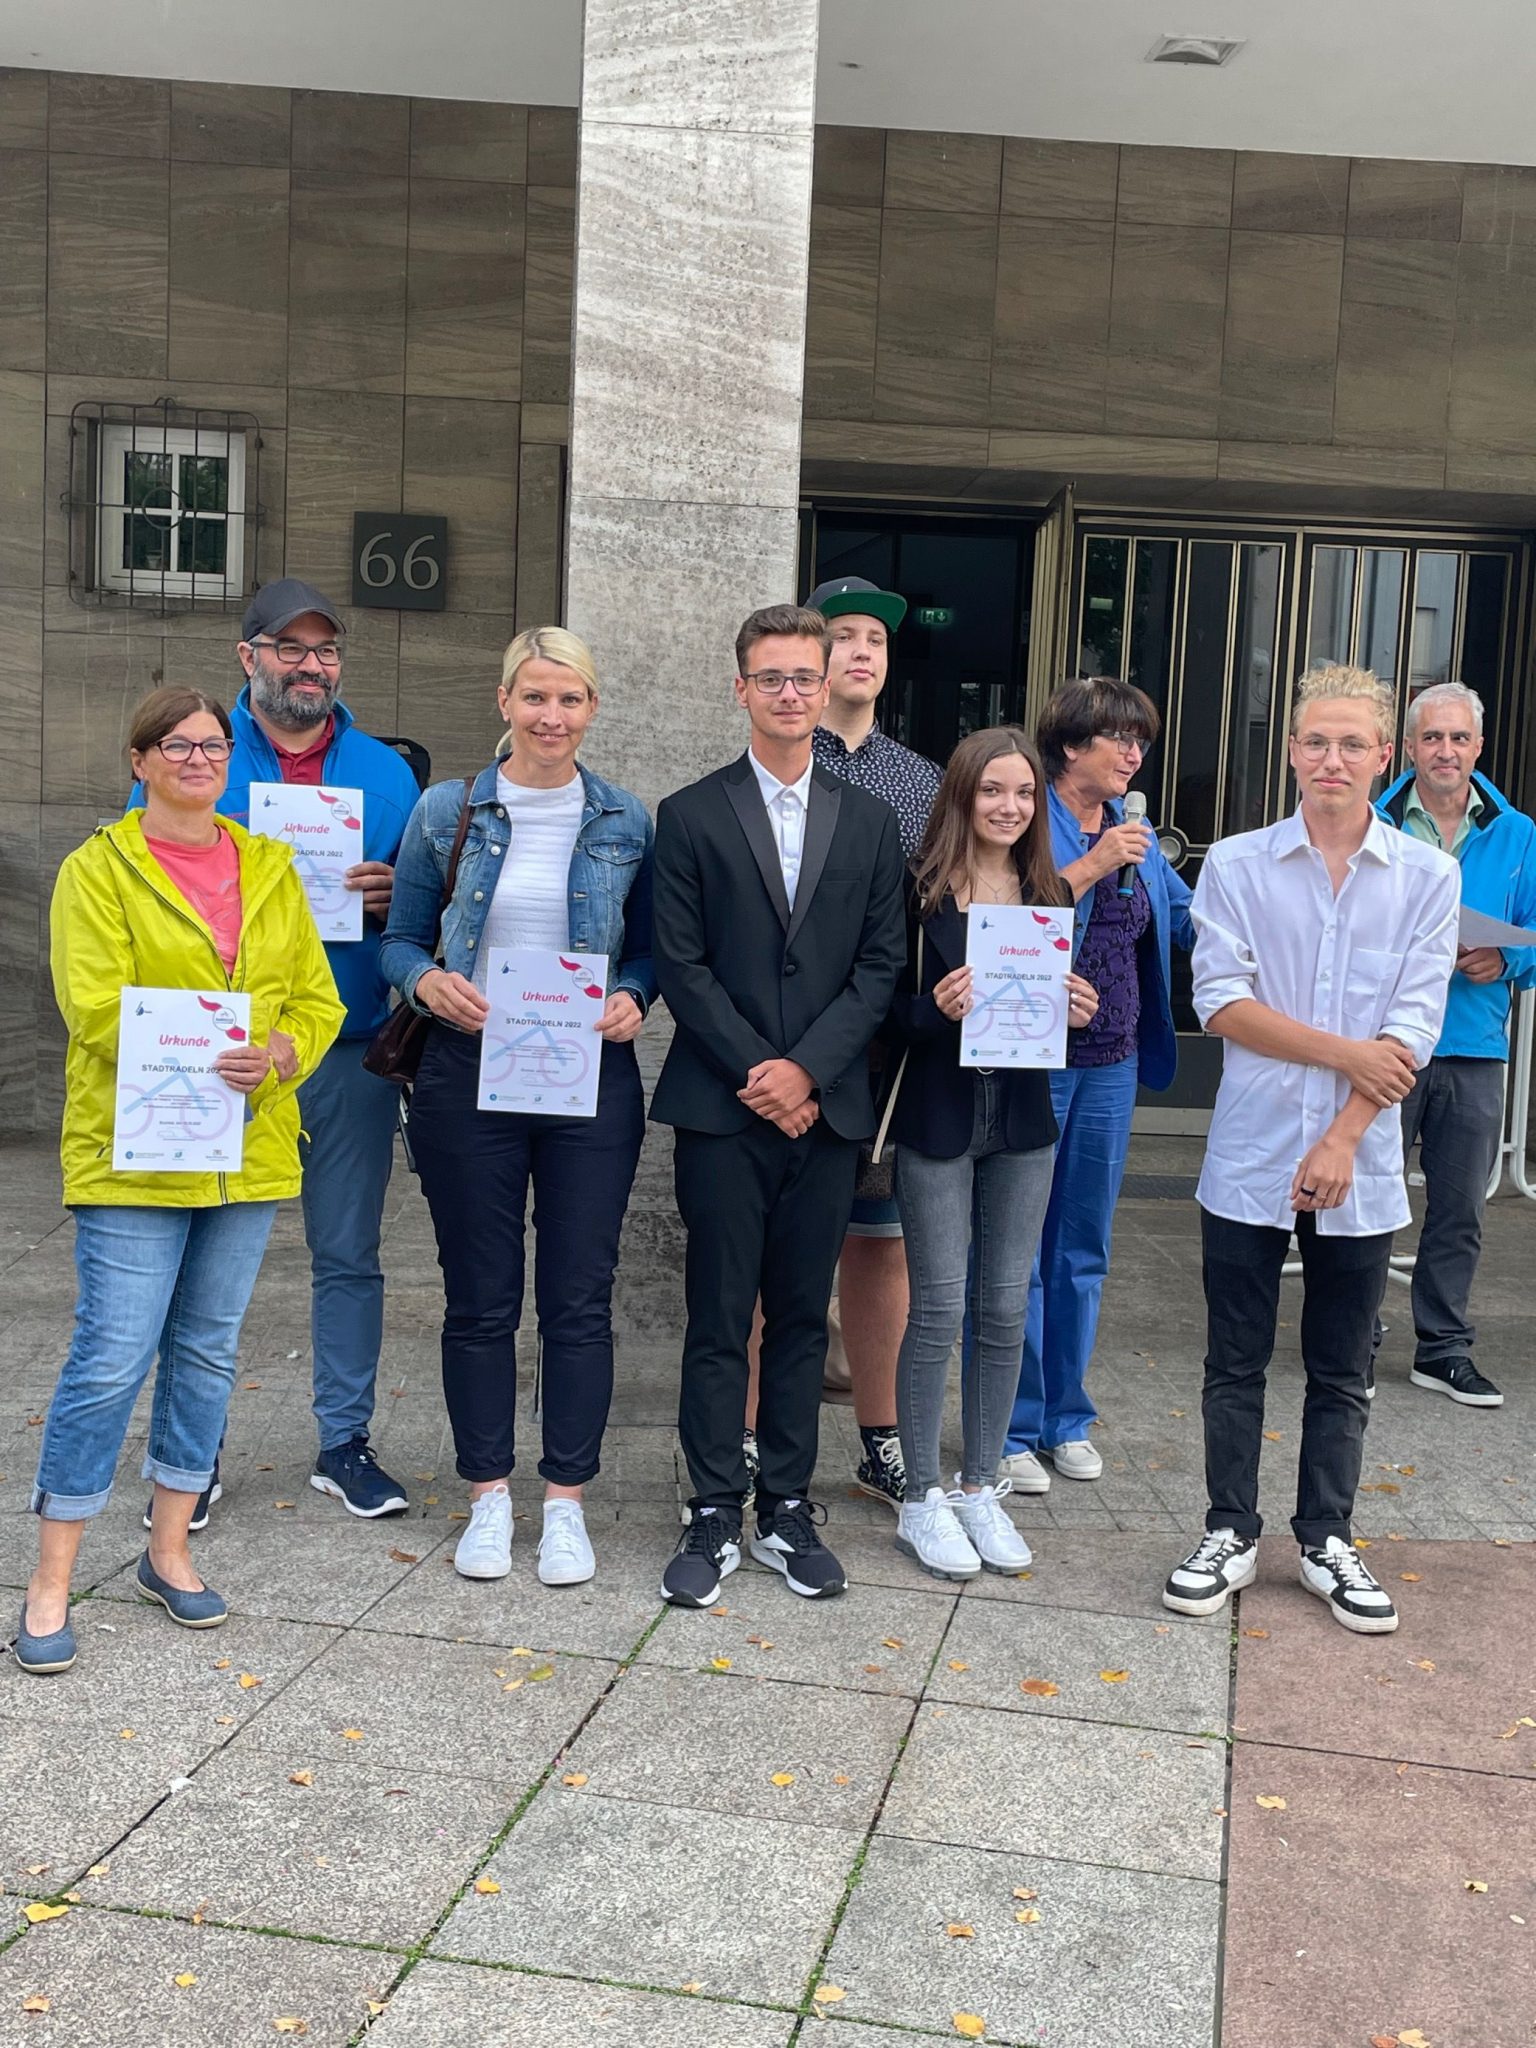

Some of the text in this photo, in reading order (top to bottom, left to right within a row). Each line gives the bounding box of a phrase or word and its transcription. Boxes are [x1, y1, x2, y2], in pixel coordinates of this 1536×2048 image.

[360, 532, 439, 590] 66
[284, 822, 330, 834] Urkunde
[295, 849, 343, 858] RADELN 2022
[999, 945, 1041, 957] Urkunde
[984, 972, 1035, 981] STADTRADELN
[522, 991, 569, 1003] Urkunde
[506, 1018, 582, 1029] STADTRADELN 2022
[159, 1034, 210, 1047] Urkunde
[141, 1064, 204, 1074] STADTRADELN
